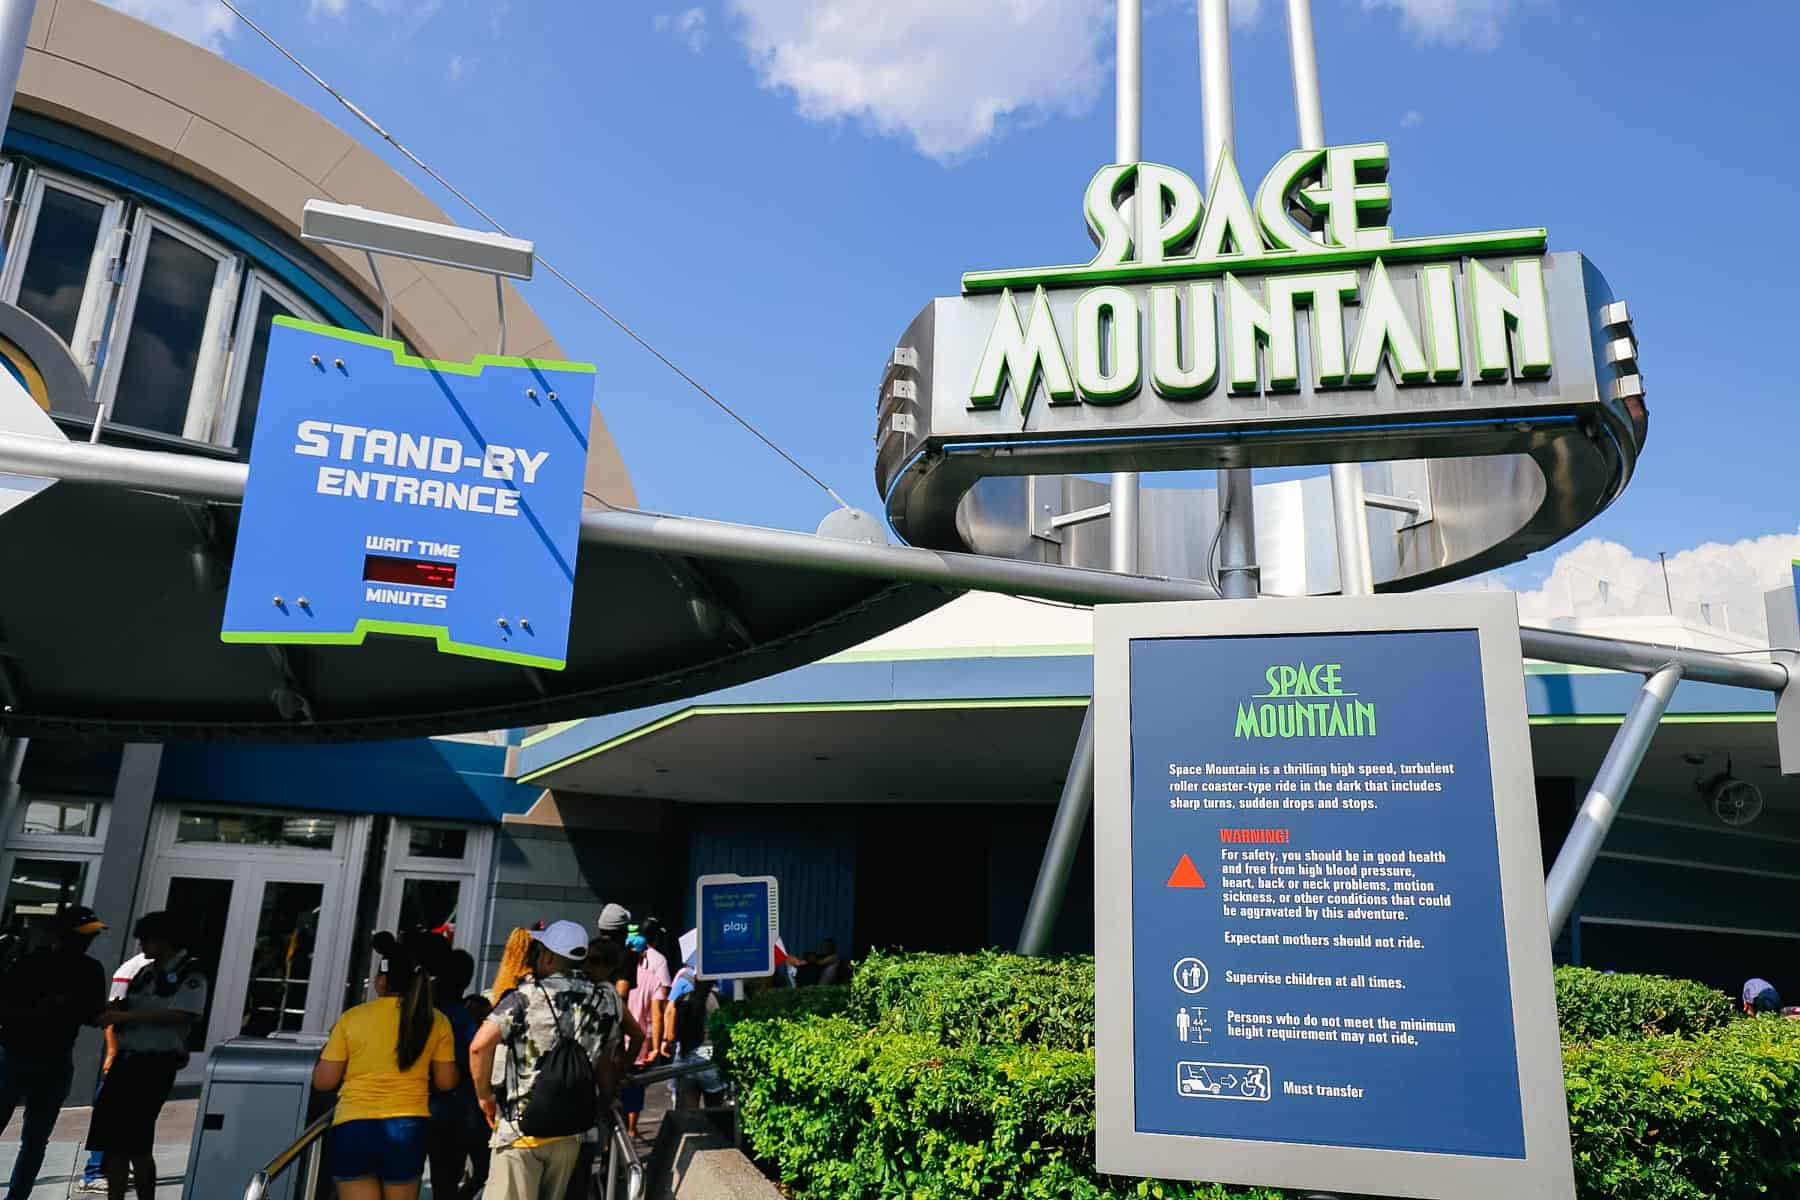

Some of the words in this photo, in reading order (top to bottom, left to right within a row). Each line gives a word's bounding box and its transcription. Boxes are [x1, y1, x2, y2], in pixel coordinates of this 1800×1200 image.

[1083, 140, 1392, 265] SPACE
[967, 257, 1553, 422] MOUNTAIN
[295, 419, 550, 484] STAND-BY
[316, 466, 520, 517] ENTRANCE
[366, 535, 413, 553] WAIT
[418, 540, 461, 558] TIME
[365, 588, 447, 609] MINUTES
[1265, 660, 1343, 697] SPACE
[1233, 698, 1377, 741] MOUNTAIN
[1169, 764, 1202, 777] Space
[1206, 764, 1256, 775] Mountain
[1260, 764, 1270, 775] is
[1274, 765, 1280, 775] a
[1283, 763, 1327, 777] thrilling
[1331, 763, 1355, 776] high
[1359, 763, 1397, 777] speed,
[1400, 763, 1455, 775] turbulent
[1169, 780, 1198, 791] roller
[1202, 781, 1272, 794] coaster-type
[1275, 780, 1296, 791] ride
[1300, 781, 1311, 791] in
[1314, 781, 1332, 791] the
[1336, 780, 1362, 791] dark
[1365, 780, 1387, 791] that
[1392, 780, 1442, 791] includes
[1169, 798, 1200, 811] sharp
[1239, 798, 1279, 809] sudden
[1283, 798, 1314, 811] drops
[1318, 798, 1339, 809] and
[1342, 798, 1378, 811] stops.
[1219, 829, 1290, 843] WARNING!
[1221, 849, 1238, 861] For
[1241, 849, 1278, 863] safety,
[1282, 853, 1301, 864] you
[1305, 850, 1342, 862] should
[1346, 850, 1359, 862] be
[1363, 850, 1374, 862] in
[1377, 851, 1405, 864] good
[1409, 851, 1446, 863] health
[1222, 863, 1242, 874] and
[1245, 864, 1266, 875] free
[1270, 864, 1295, 875] from
[1298, 864, 1322, 877] high
[1326, 864, 1357, 876] blood
[1361, 867, 1416, 878] pressure,
[1258, 878, 1284, 889] back
[1288, 880, 1300, 890] or
[1302, 878, 1330, 890] neck
[1333, 879, 1390, 892] problems,
[1394, 880, 1434, 892] motion
[1222, 892, 1276, 904] sickness,
[1279, 895, 1291, 903] or
[1294, 893, 1324, 904] other
[1327, 893, 1388, 905] conditions
[1391, 894, 1415, 906] that
[1419, 895, 1451, 906] could
[1223, 904, 1237, 916] be
[1240, 905, 1302, 919] aggravated
[1305, 906, 1318, 920] by
[1322, 907, 1344, 919] this
[1347, 907, 1409, 920] adventure.
[723, 921, 748, 933] play
[1224, 931, 1279, 946] Expectant
[1282, 934, 1329, 946] mothers
[1333, 935, 1371, 947] should
[1375, 937, 1394, 948] not
[1398, 937, 1425, 949] ride.
[1225, 971, 1282, 985] Supervise
[1285, 972, 1332, 986] children
[1335, 976, 1348, 987] at
[1351, 975, 1365, 987] all
[1368, 976, 1406, 989] times.
[1227, 1011, 1272, 1024] Persons
[1276, 1013, 1300, 1025] who
[1303, 1014, 1318, 1026] do
[1321, 1016, 1341, 1027] not
[1344, 1017, 1374, 1029] meet
[1377, 1017, 1397, 1029] the
[1400, 1020, 1456, 1032] minimum
[1228, 1026, 1264, 1040] height
[1267, 1028, 1338, 1042] requirement
[1341, 1032, 1364, 1044] may
[1368, 1032, 1388, 1044] not
[1284, 1082, 1313, 1096] Must
[1317, 1084, 1364, 1098] transfer
